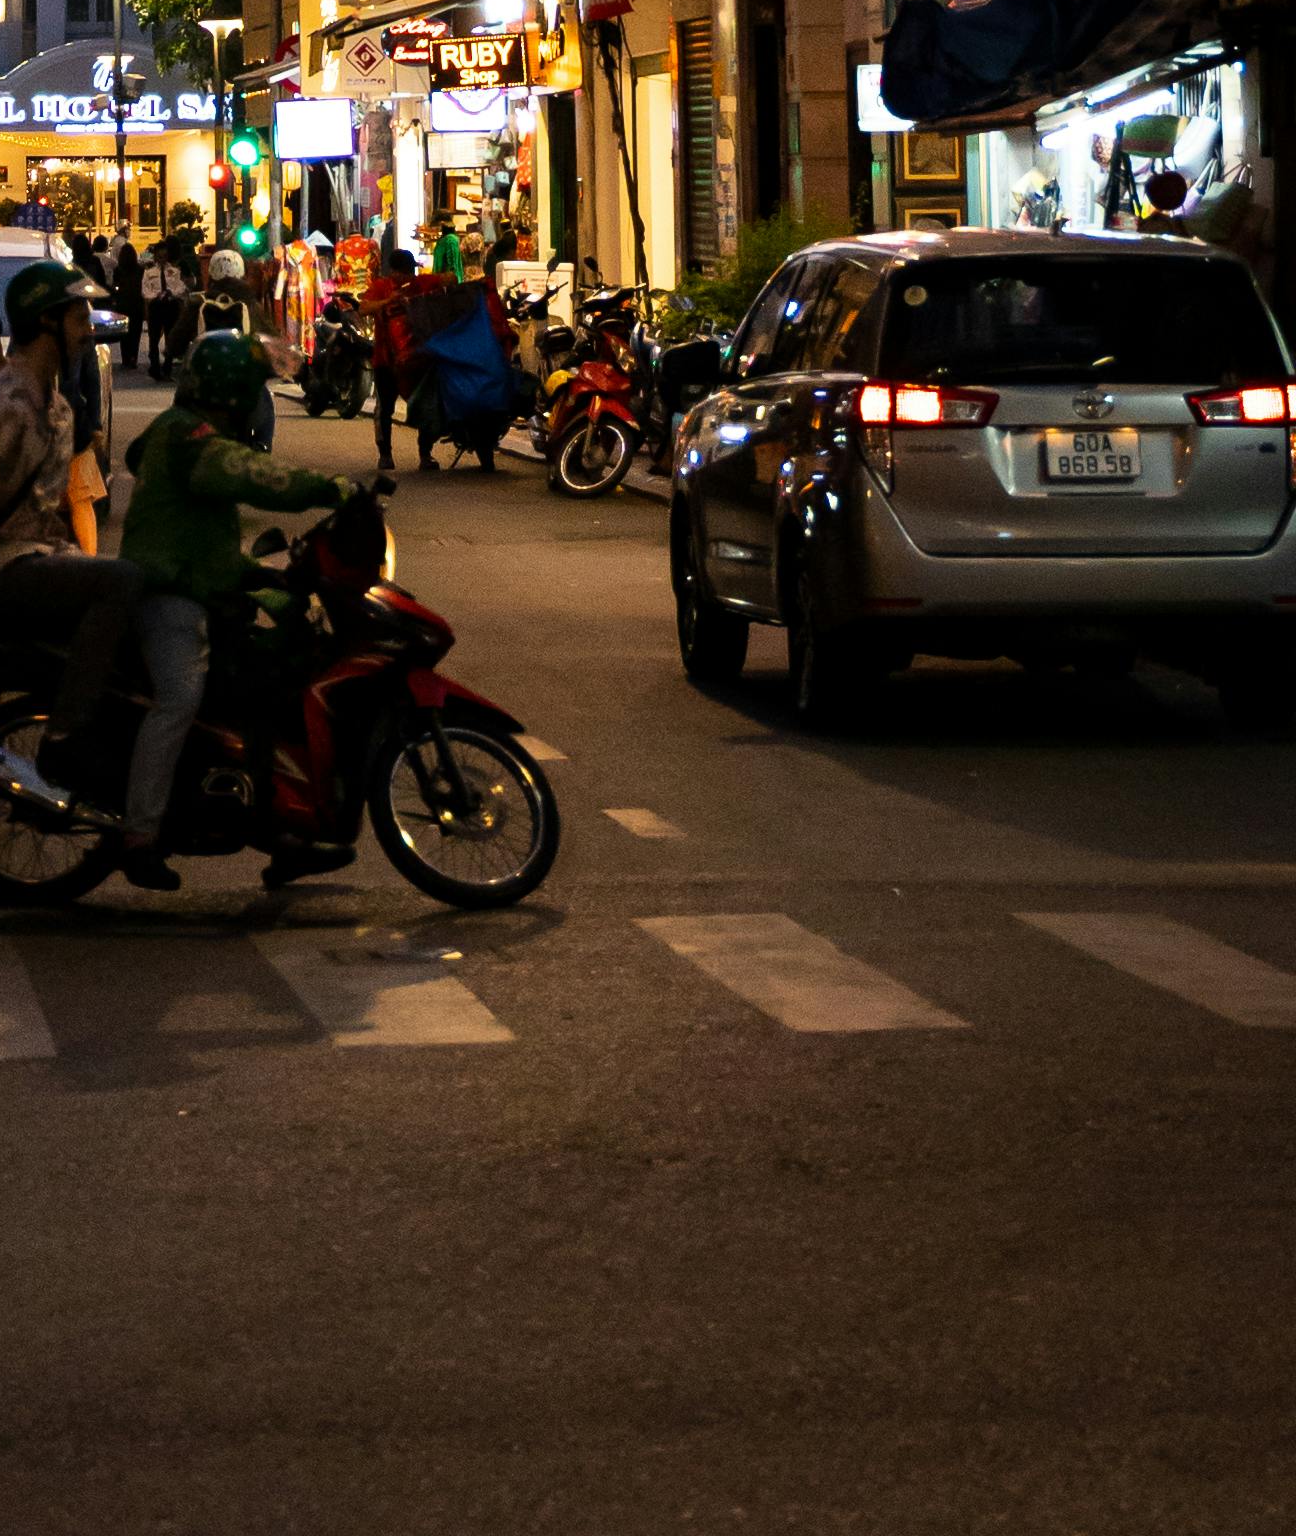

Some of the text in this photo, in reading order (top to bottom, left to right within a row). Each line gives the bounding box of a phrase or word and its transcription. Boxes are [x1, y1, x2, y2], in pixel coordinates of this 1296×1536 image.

[439, 39, 515, 70] RUBY
[459, 68, 501, 87] Shop
[1073, 433, 1113, 453] 60A
